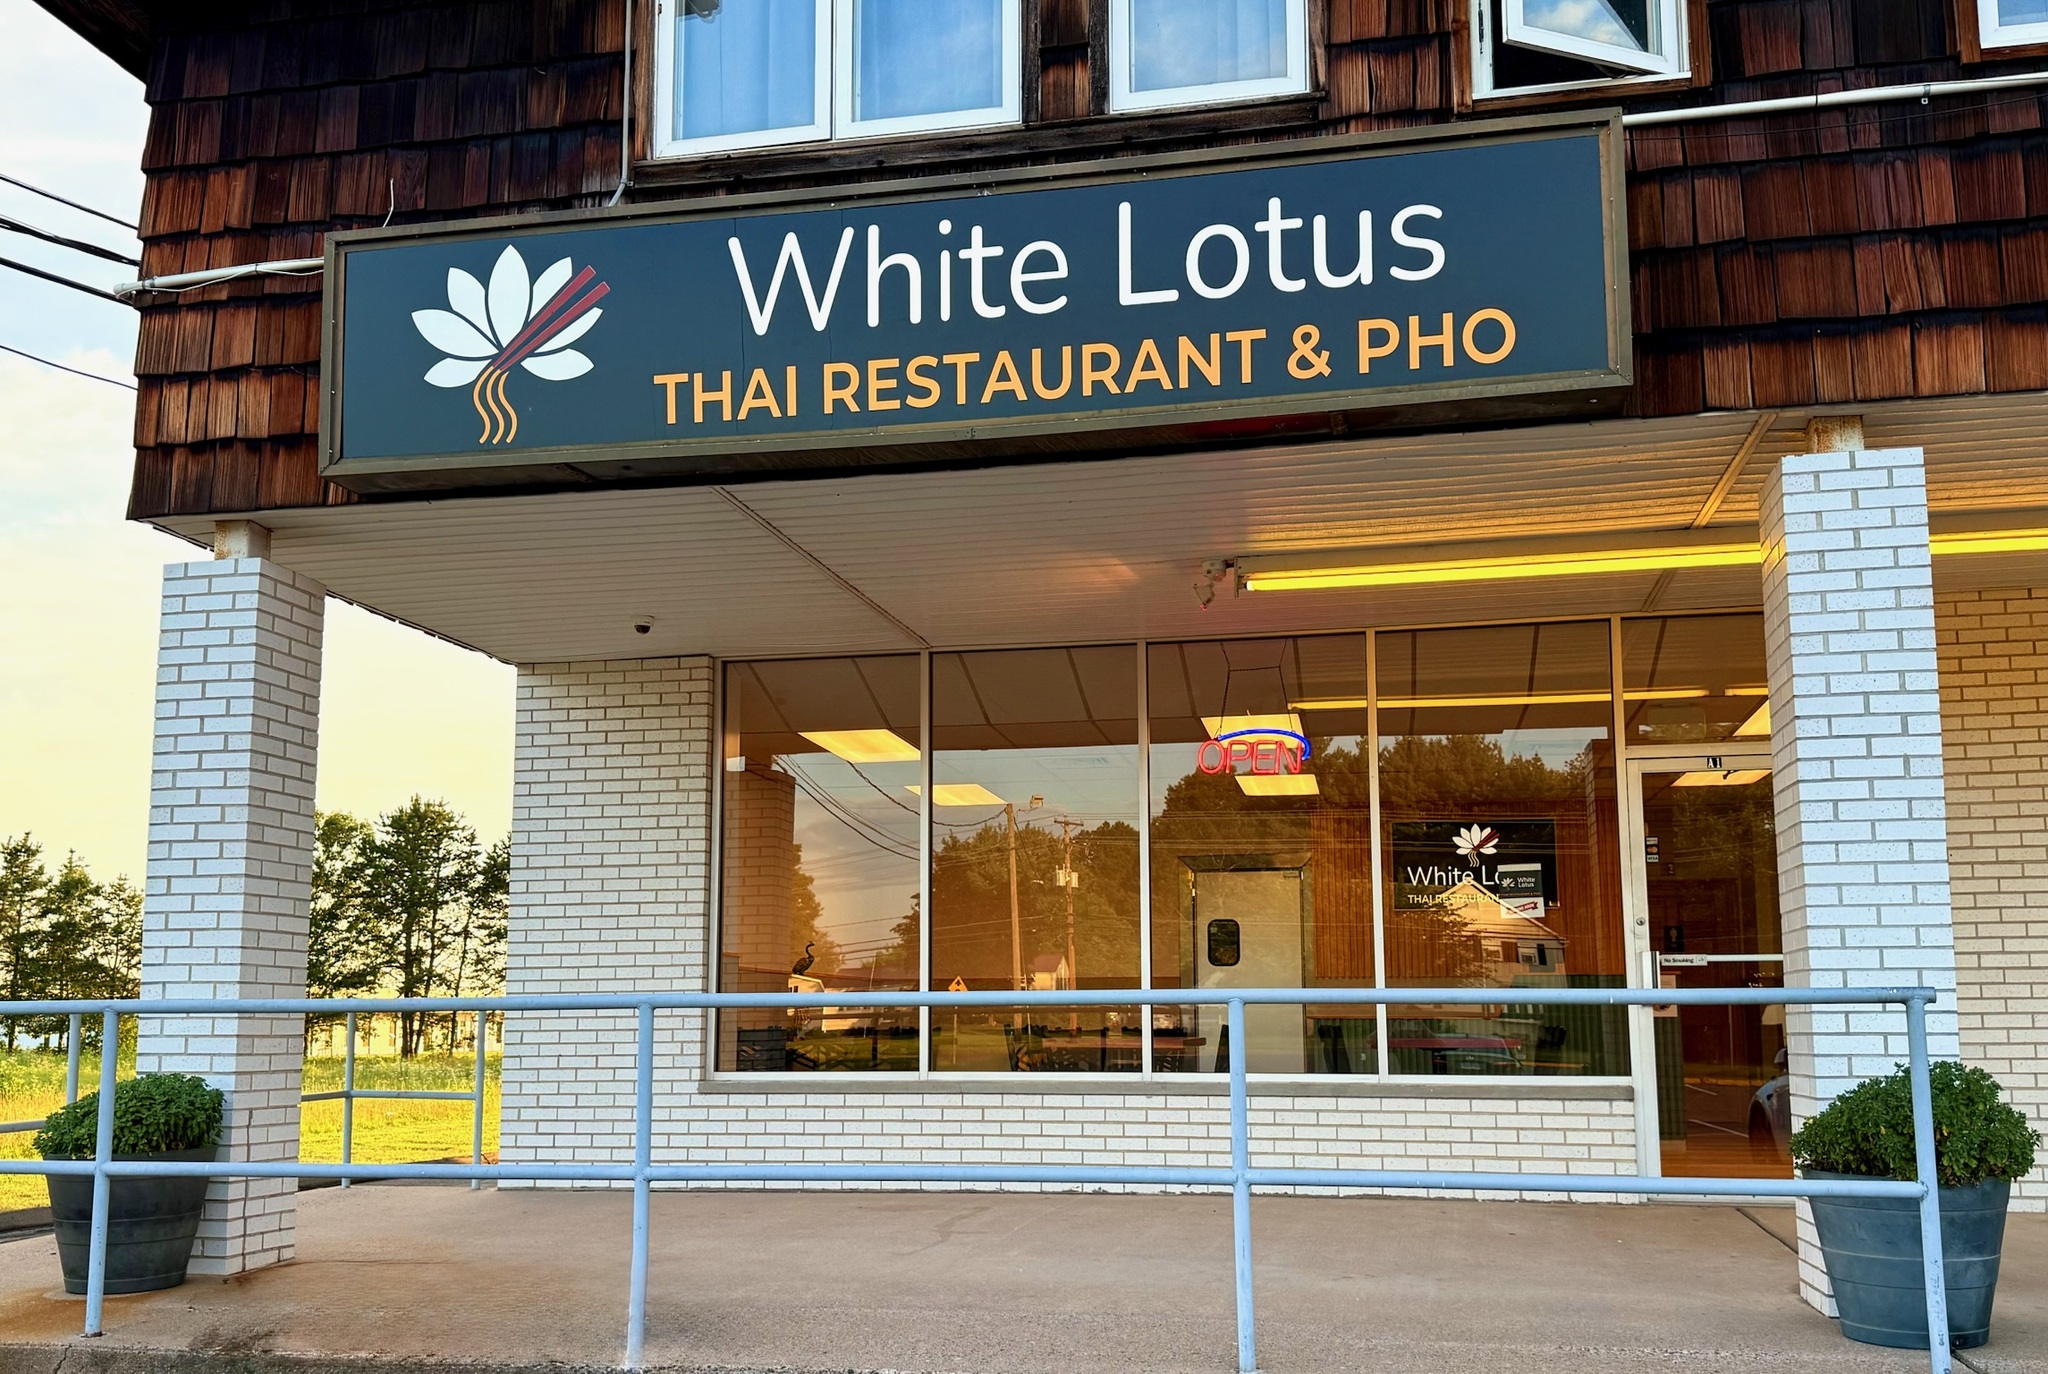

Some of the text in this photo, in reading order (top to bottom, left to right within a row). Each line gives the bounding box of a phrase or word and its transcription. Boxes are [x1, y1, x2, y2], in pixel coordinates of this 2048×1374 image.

[728, 196, 1446, 336] White Lotus
[653, 307, 1517, 425] THAI RESTAURANT & PHO
[1198, 739, 1302, 775] OPEN
[1407, 865, 1474, 886] White
[1407, 894, 1433, 904] THAI
[1435, 893, 1501, 904] RESTAURAN
